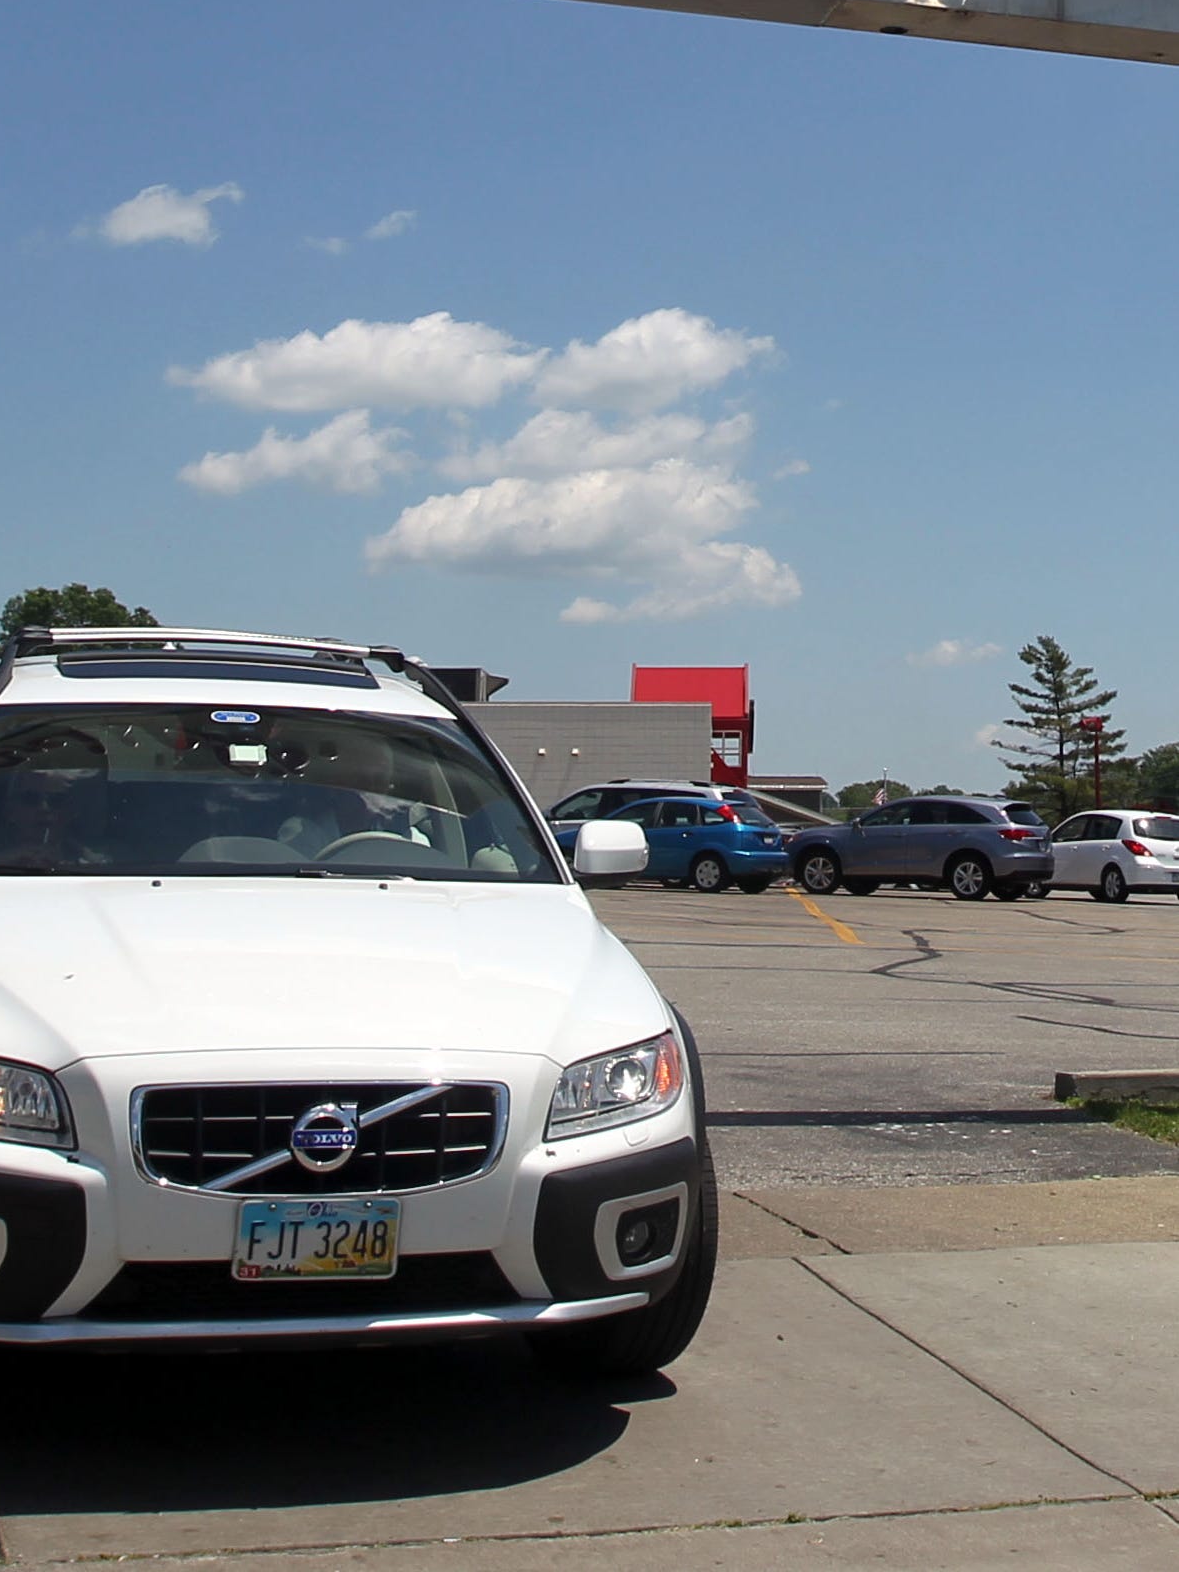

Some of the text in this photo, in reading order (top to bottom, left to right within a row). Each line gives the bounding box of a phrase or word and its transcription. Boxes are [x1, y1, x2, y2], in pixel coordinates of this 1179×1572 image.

[297, 1133, 352, 1144] OLVO
[247, 1219, 388, 1260] FJT 3248
